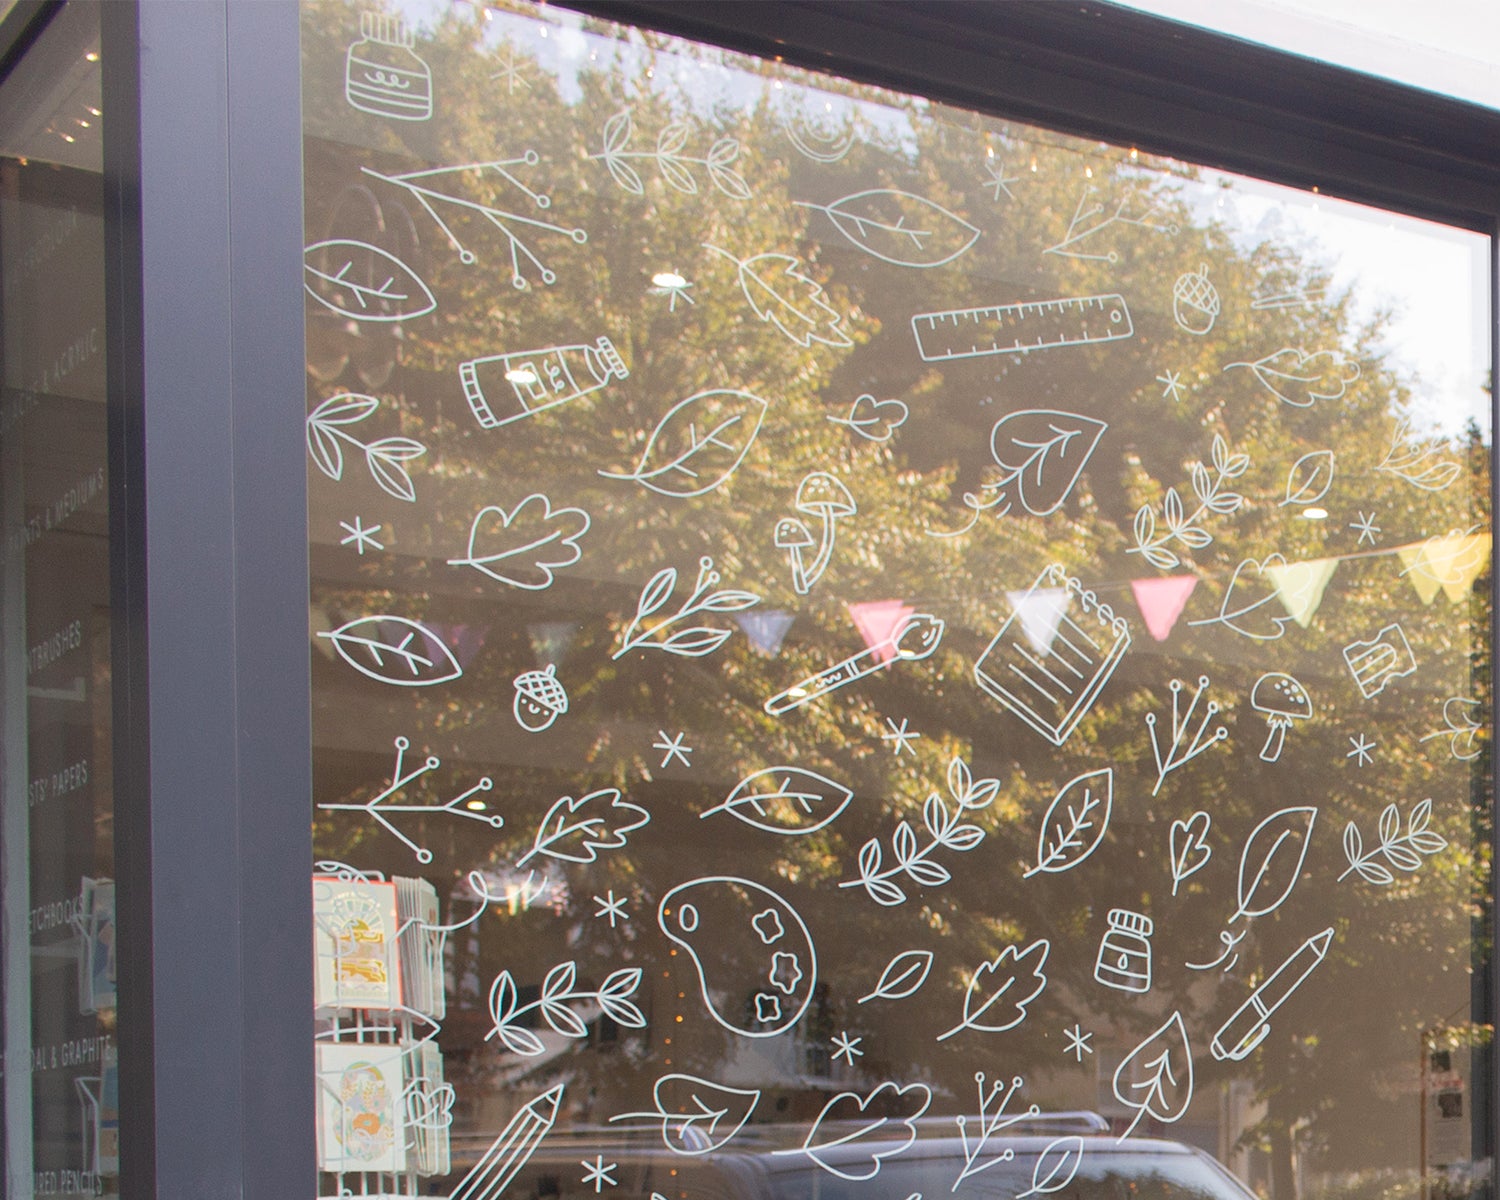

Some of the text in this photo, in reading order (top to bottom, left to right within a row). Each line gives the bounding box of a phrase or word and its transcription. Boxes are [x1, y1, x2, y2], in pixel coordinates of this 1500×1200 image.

[26, 618, 82, 675] NTBRUSHES
[52, 759, 89, 796] PAPERS
[61, 1034, 112, 1067] GRAPHITE
[60, 1170, 102, 1197] PENCILS
